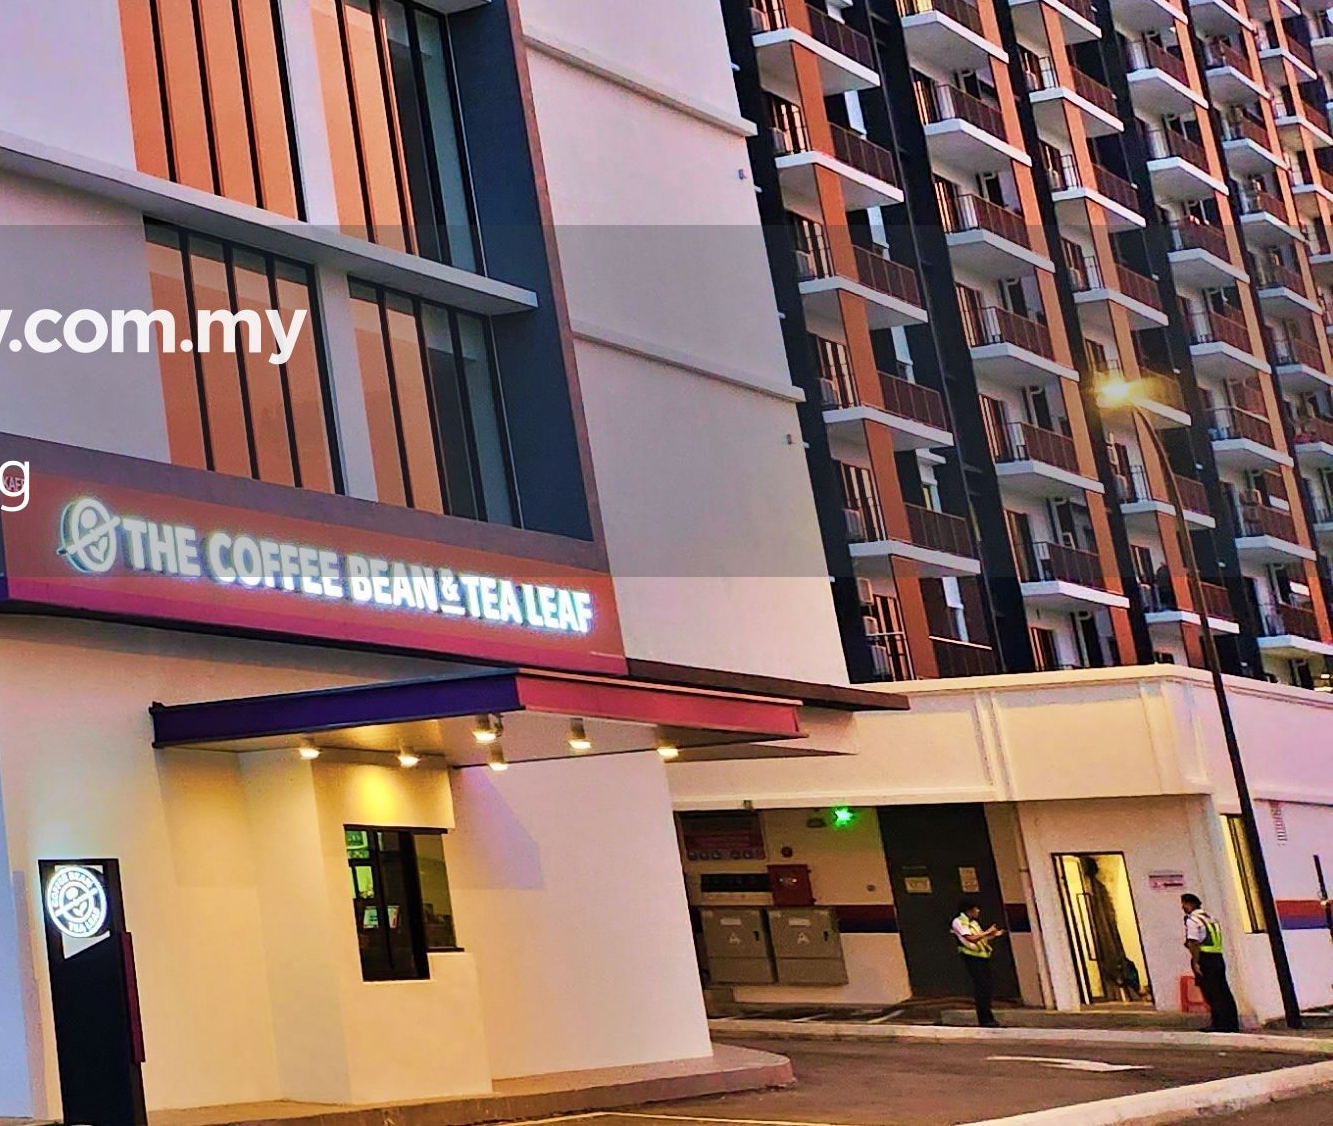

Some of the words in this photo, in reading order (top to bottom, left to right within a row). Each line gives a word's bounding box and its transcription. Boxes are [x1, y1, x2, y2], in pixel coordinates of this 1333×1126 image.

[123, 517, 201, 577] THE
[207, 531, 343, 600] COFFEE
[346, 554, 438, 613] BEAN
[460, 574, 524, 628] TEA
[524, 582, 593, 633] LEAF
